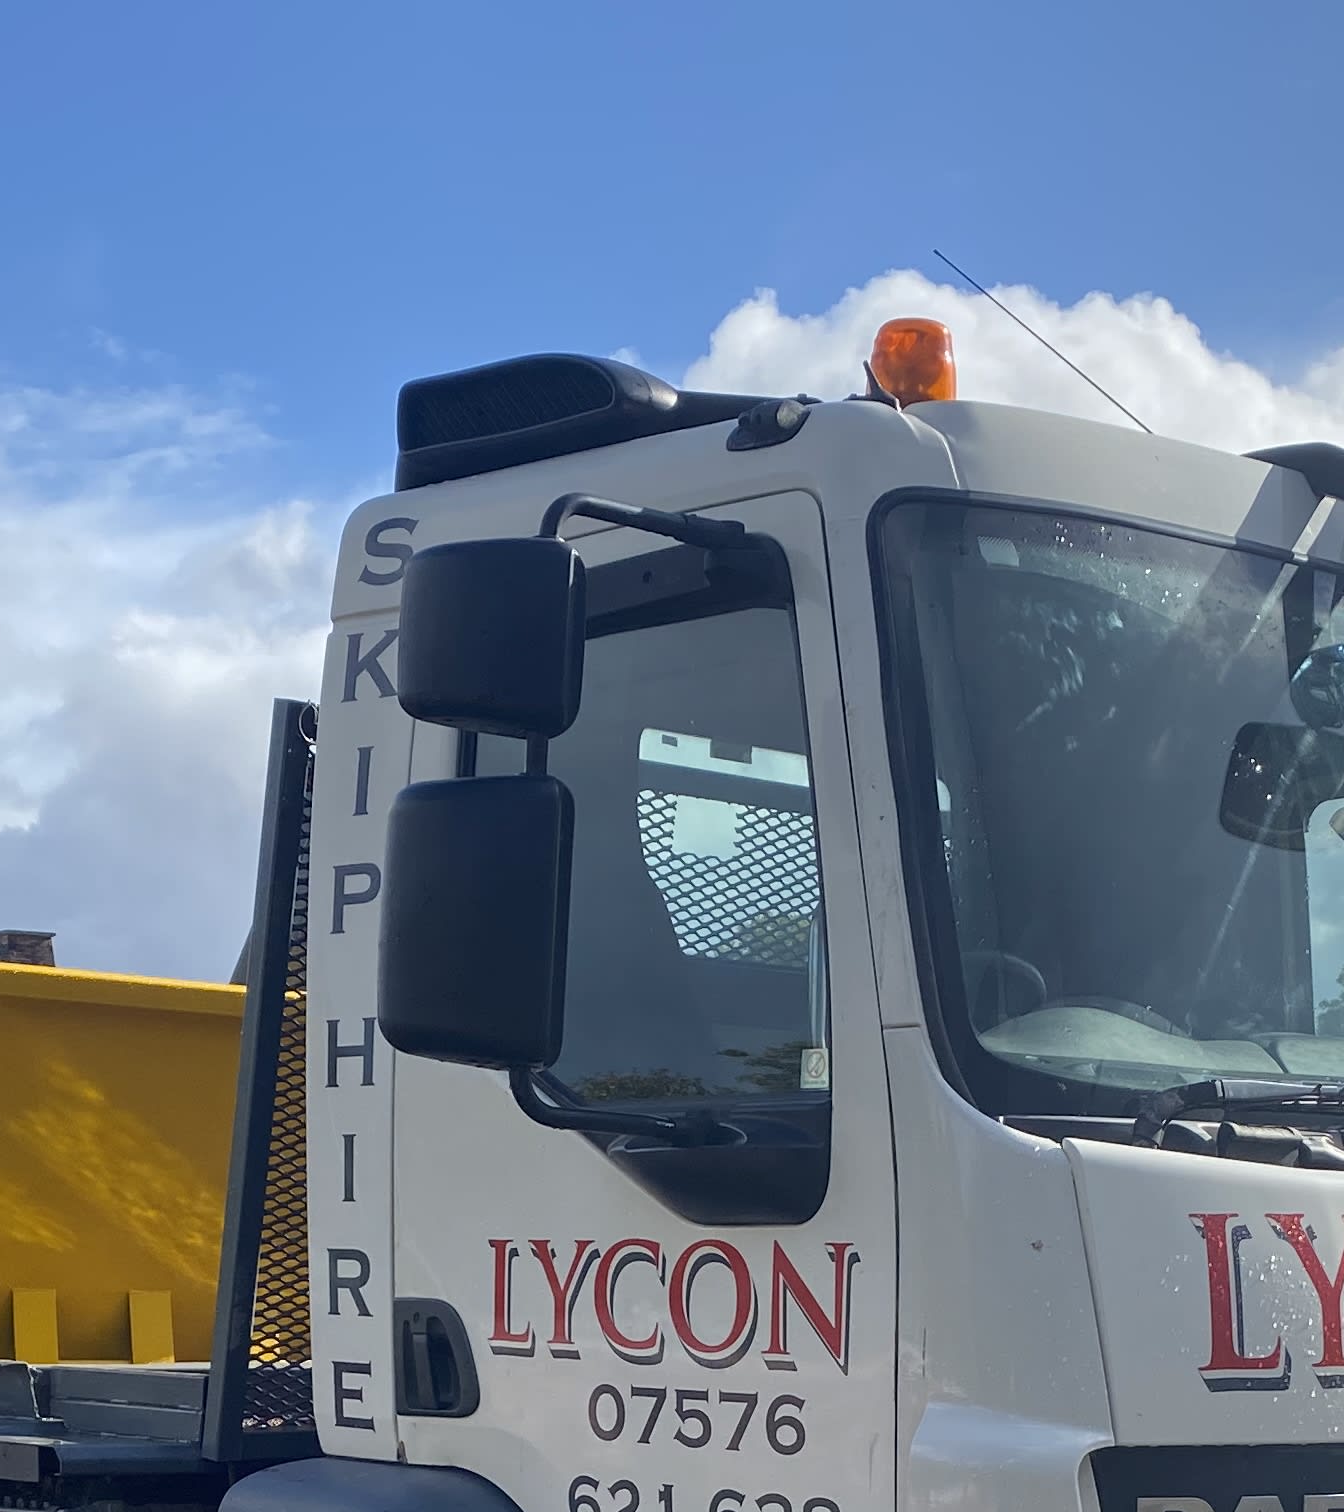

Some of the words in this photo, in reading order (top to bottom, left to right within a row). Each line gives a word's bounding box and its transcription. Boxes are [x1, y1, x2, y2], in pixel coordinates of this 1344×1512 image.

[330, 517, 419, 935] SKIP
[325, 1016, 376, 1433] HIRE
[488, 1238, 860, 1376] LYCON
[588, 1383, 807, 1456] 07576
